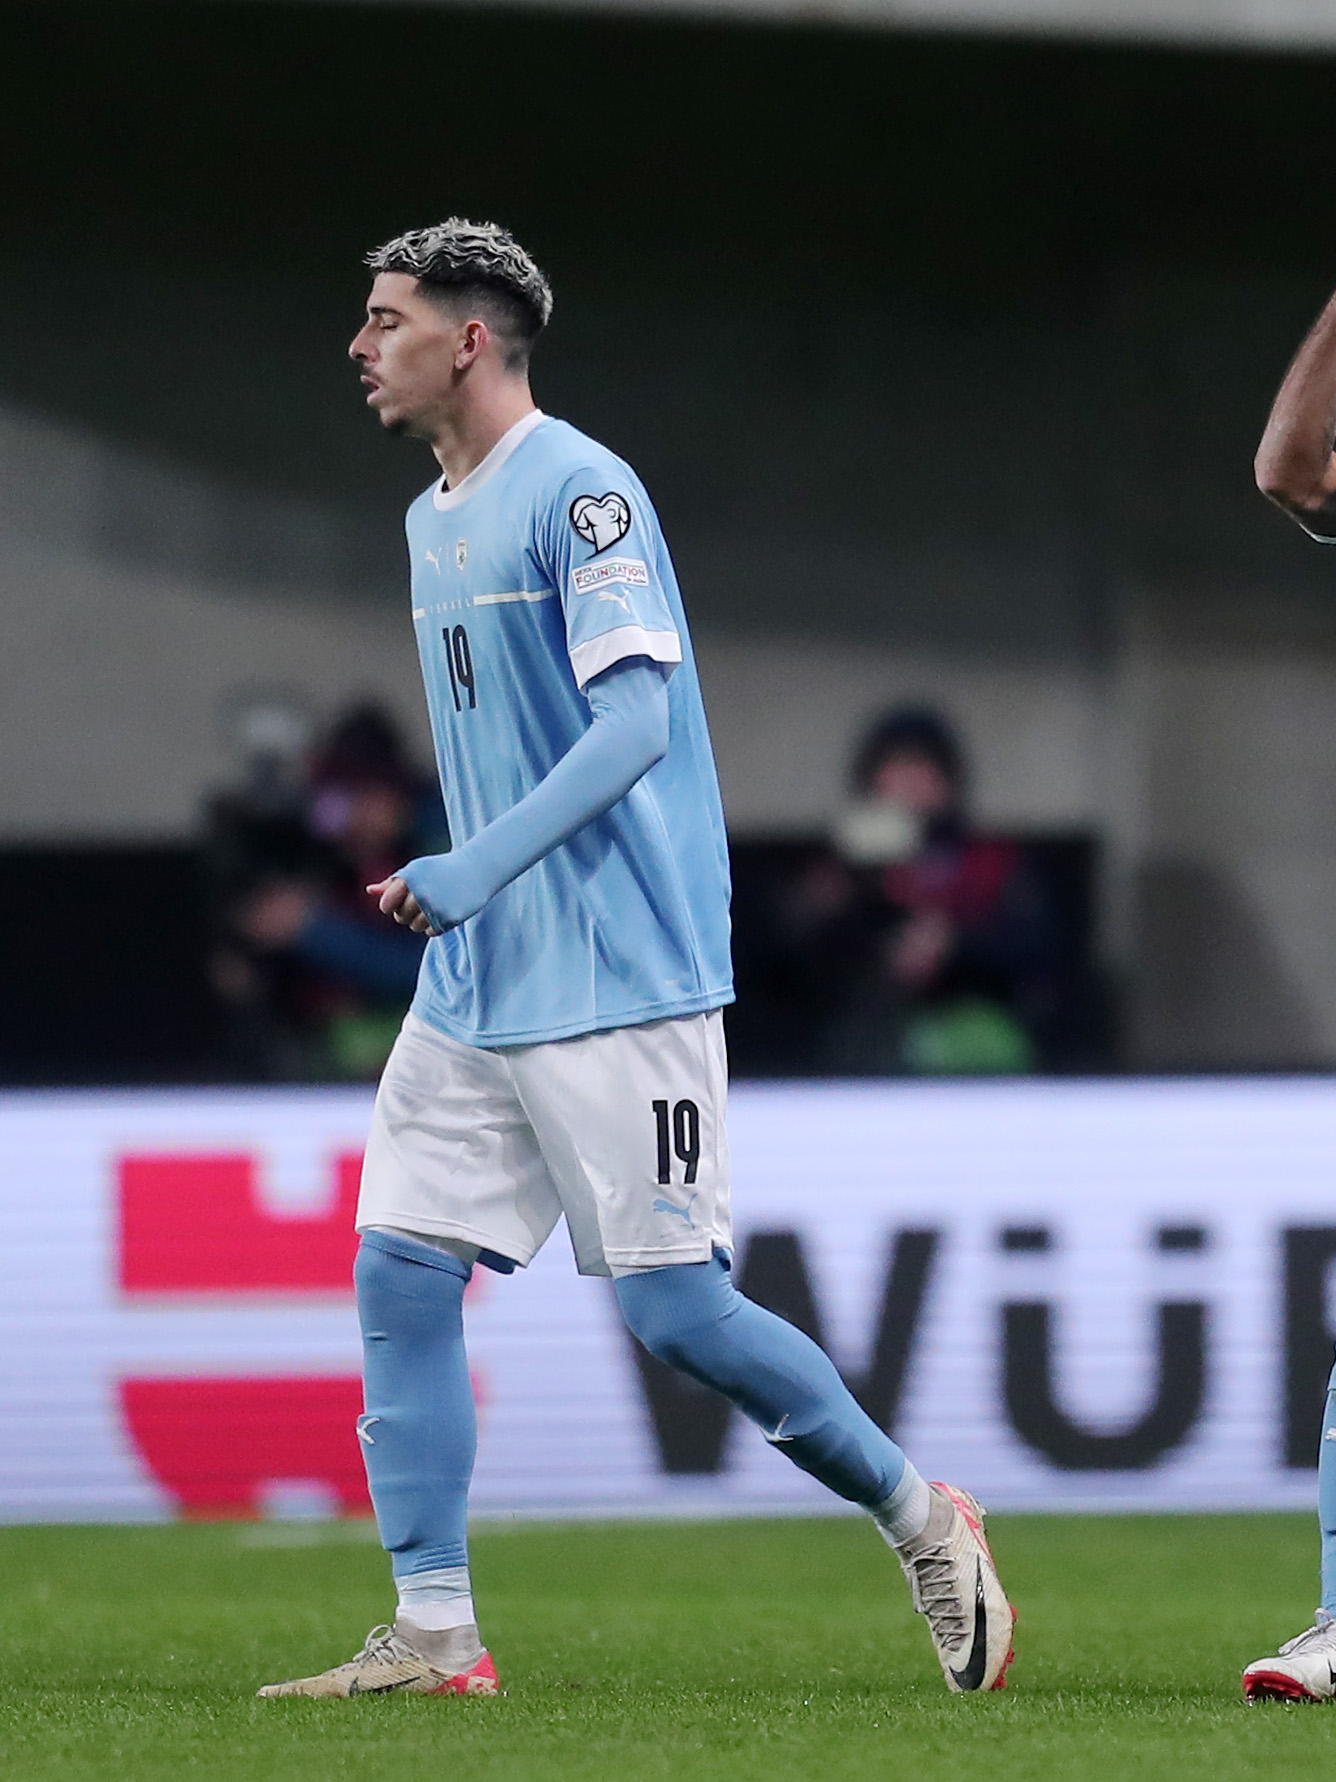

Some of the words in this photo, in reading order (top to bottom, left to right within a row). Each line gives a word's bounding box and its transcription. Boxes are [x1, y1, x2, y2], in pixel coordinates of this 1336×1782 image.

[575, 565, 646, 586] FOUNDATION
[442, 624, 476, 712] 19
[652, 1098, 700, 1184] 19
